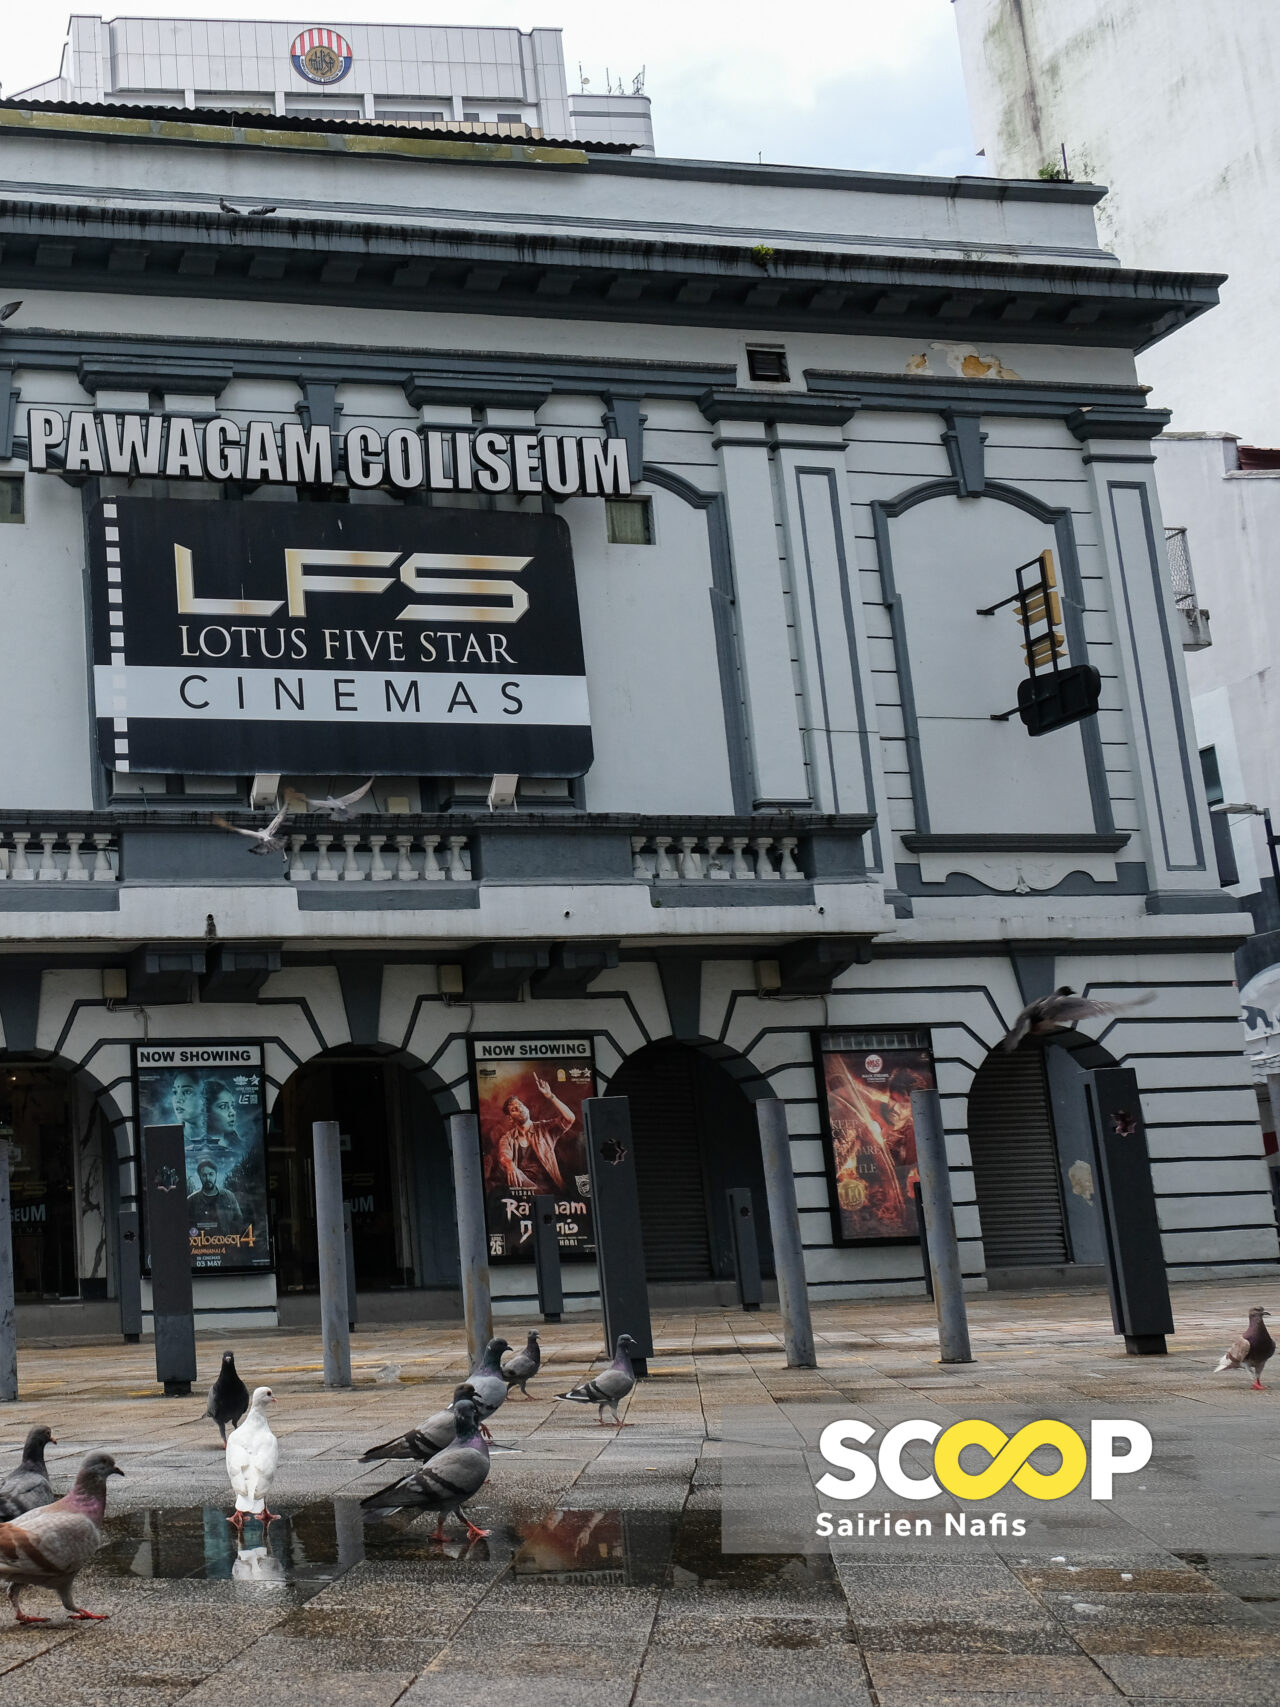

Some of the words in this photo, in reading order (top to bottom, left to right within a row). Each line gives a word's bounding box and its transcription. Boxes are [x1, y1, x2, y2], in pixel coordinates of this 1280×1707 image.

[27, 408, 333, 484] PAWAGAM
[345, 425, 631, 497] COLISEUM
[174, 543, 534, 623] LFS
[179, 625, 307, 659] LOTUS
[322, 629, 405, 661] FIVE
[420, 631, 518, 664] STAR
[179, 674, 523, 715] CINEMAS
[140, 1051, 175, 1062] NOW
[180, 1050, 251, 1062] SHOWING
[482, 1045, 515, 1056] NOW
[520, 1044, 586, 1055] SHOWING
[501, 1198, 587, 1221] Raam
